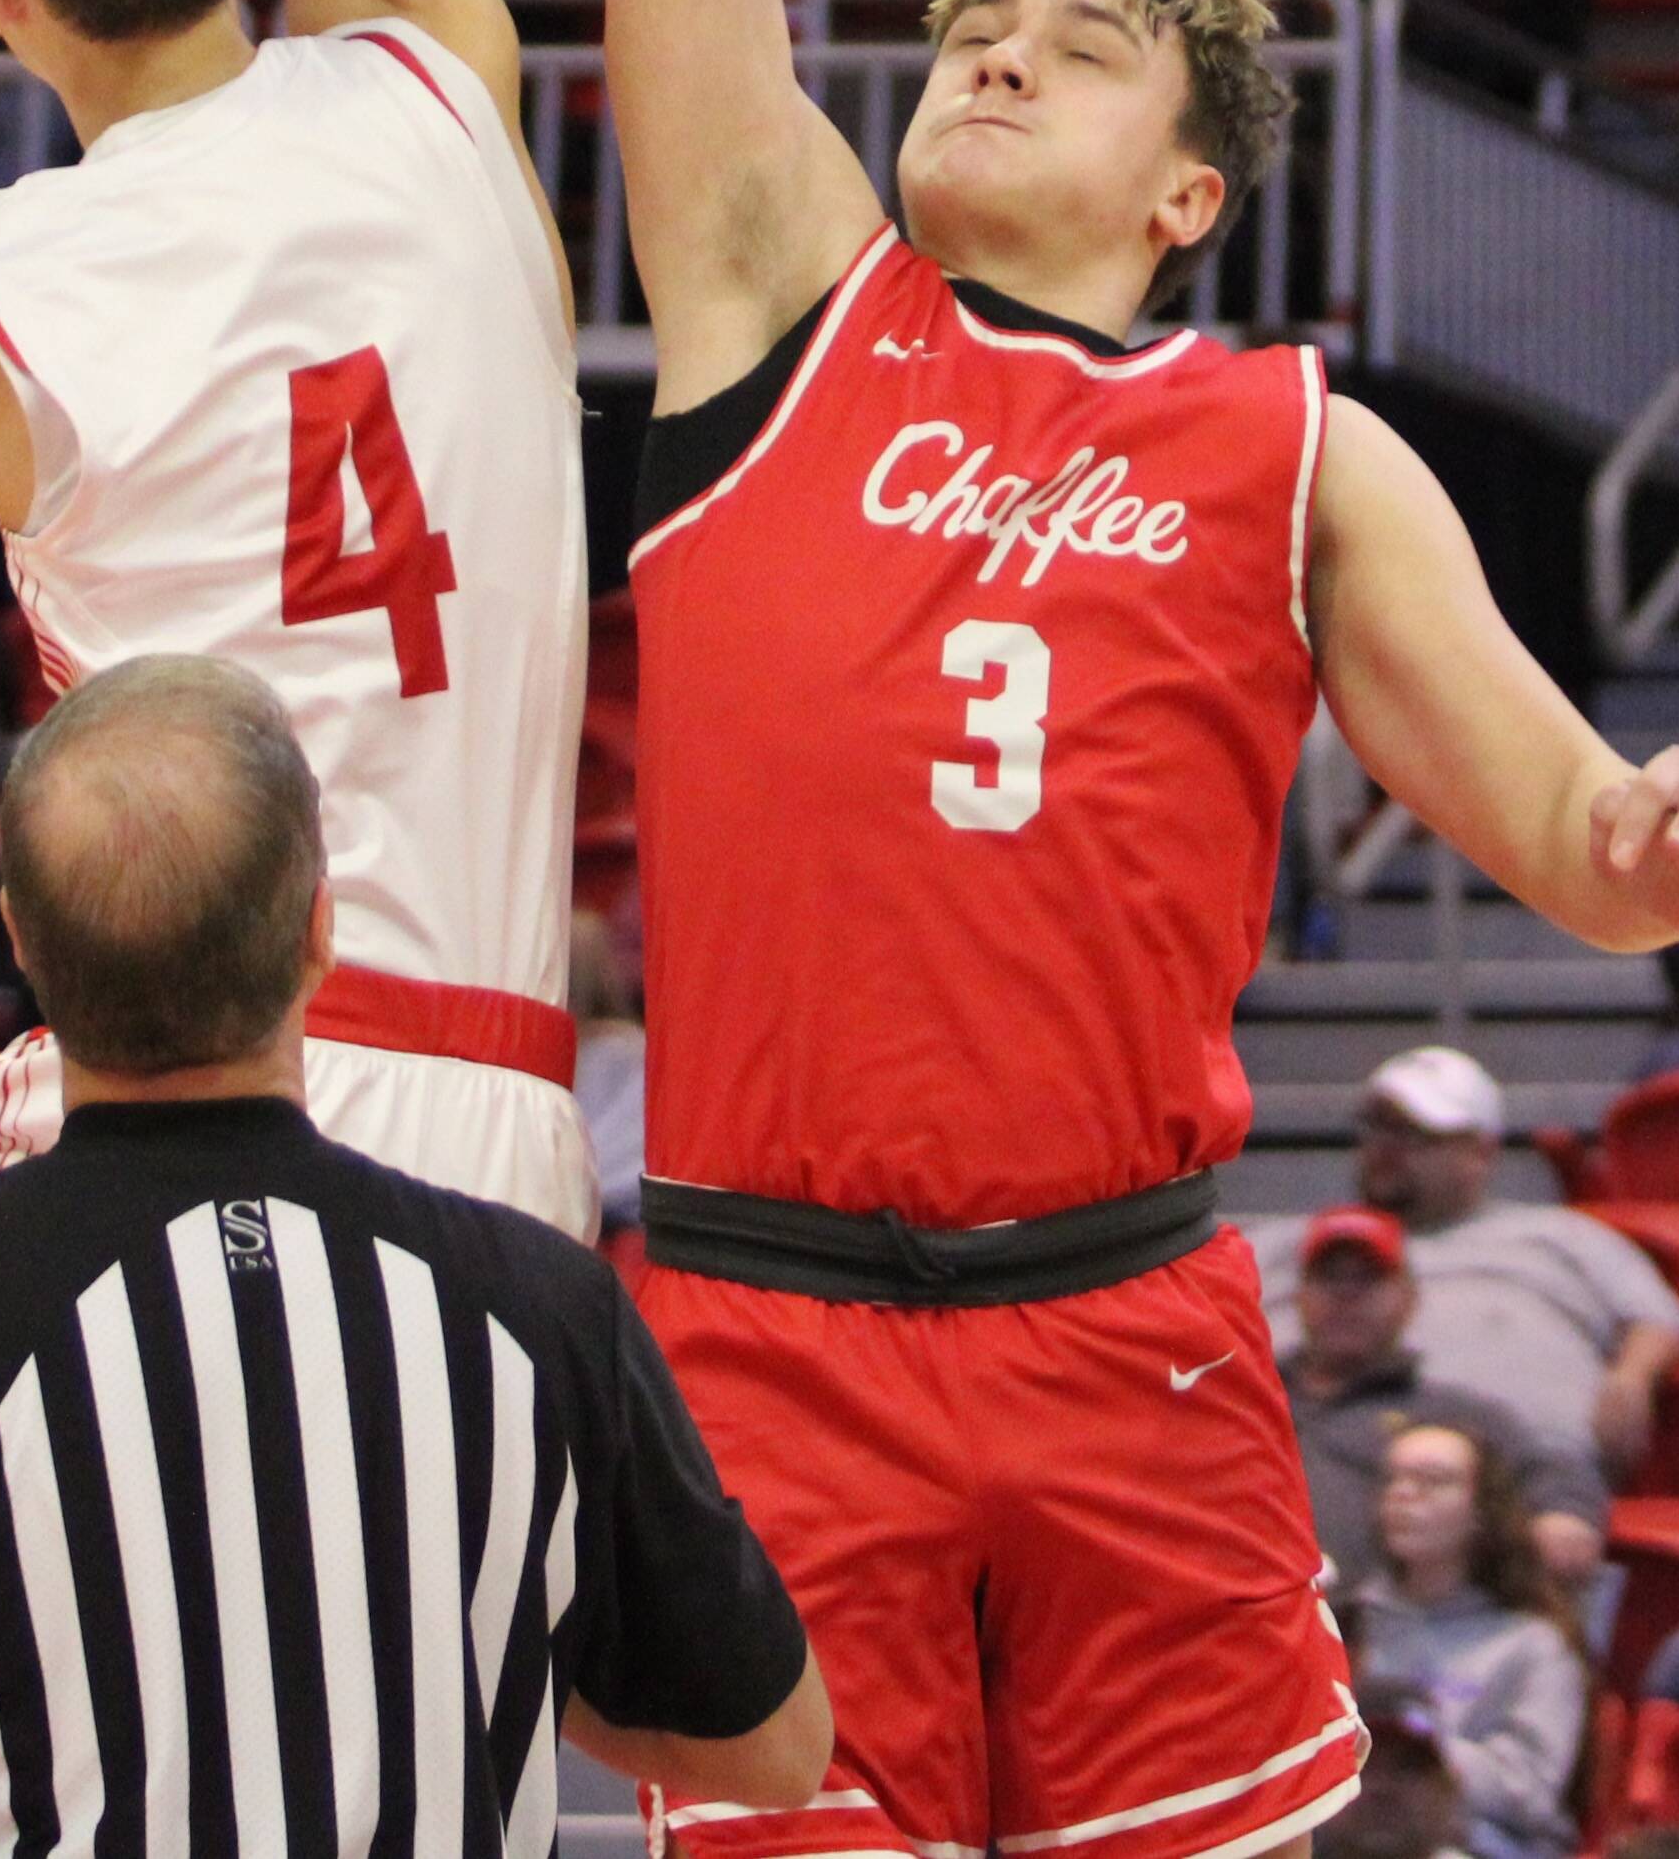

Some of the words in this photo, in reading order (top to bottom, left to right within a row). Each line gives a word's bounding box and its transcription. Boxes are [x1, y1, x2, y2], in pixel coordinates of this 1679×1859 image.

[281, 343, 458, 699] 4
[862, 420, 1189, 587] Chaffee
[931, 618, 1052, 833] 3
